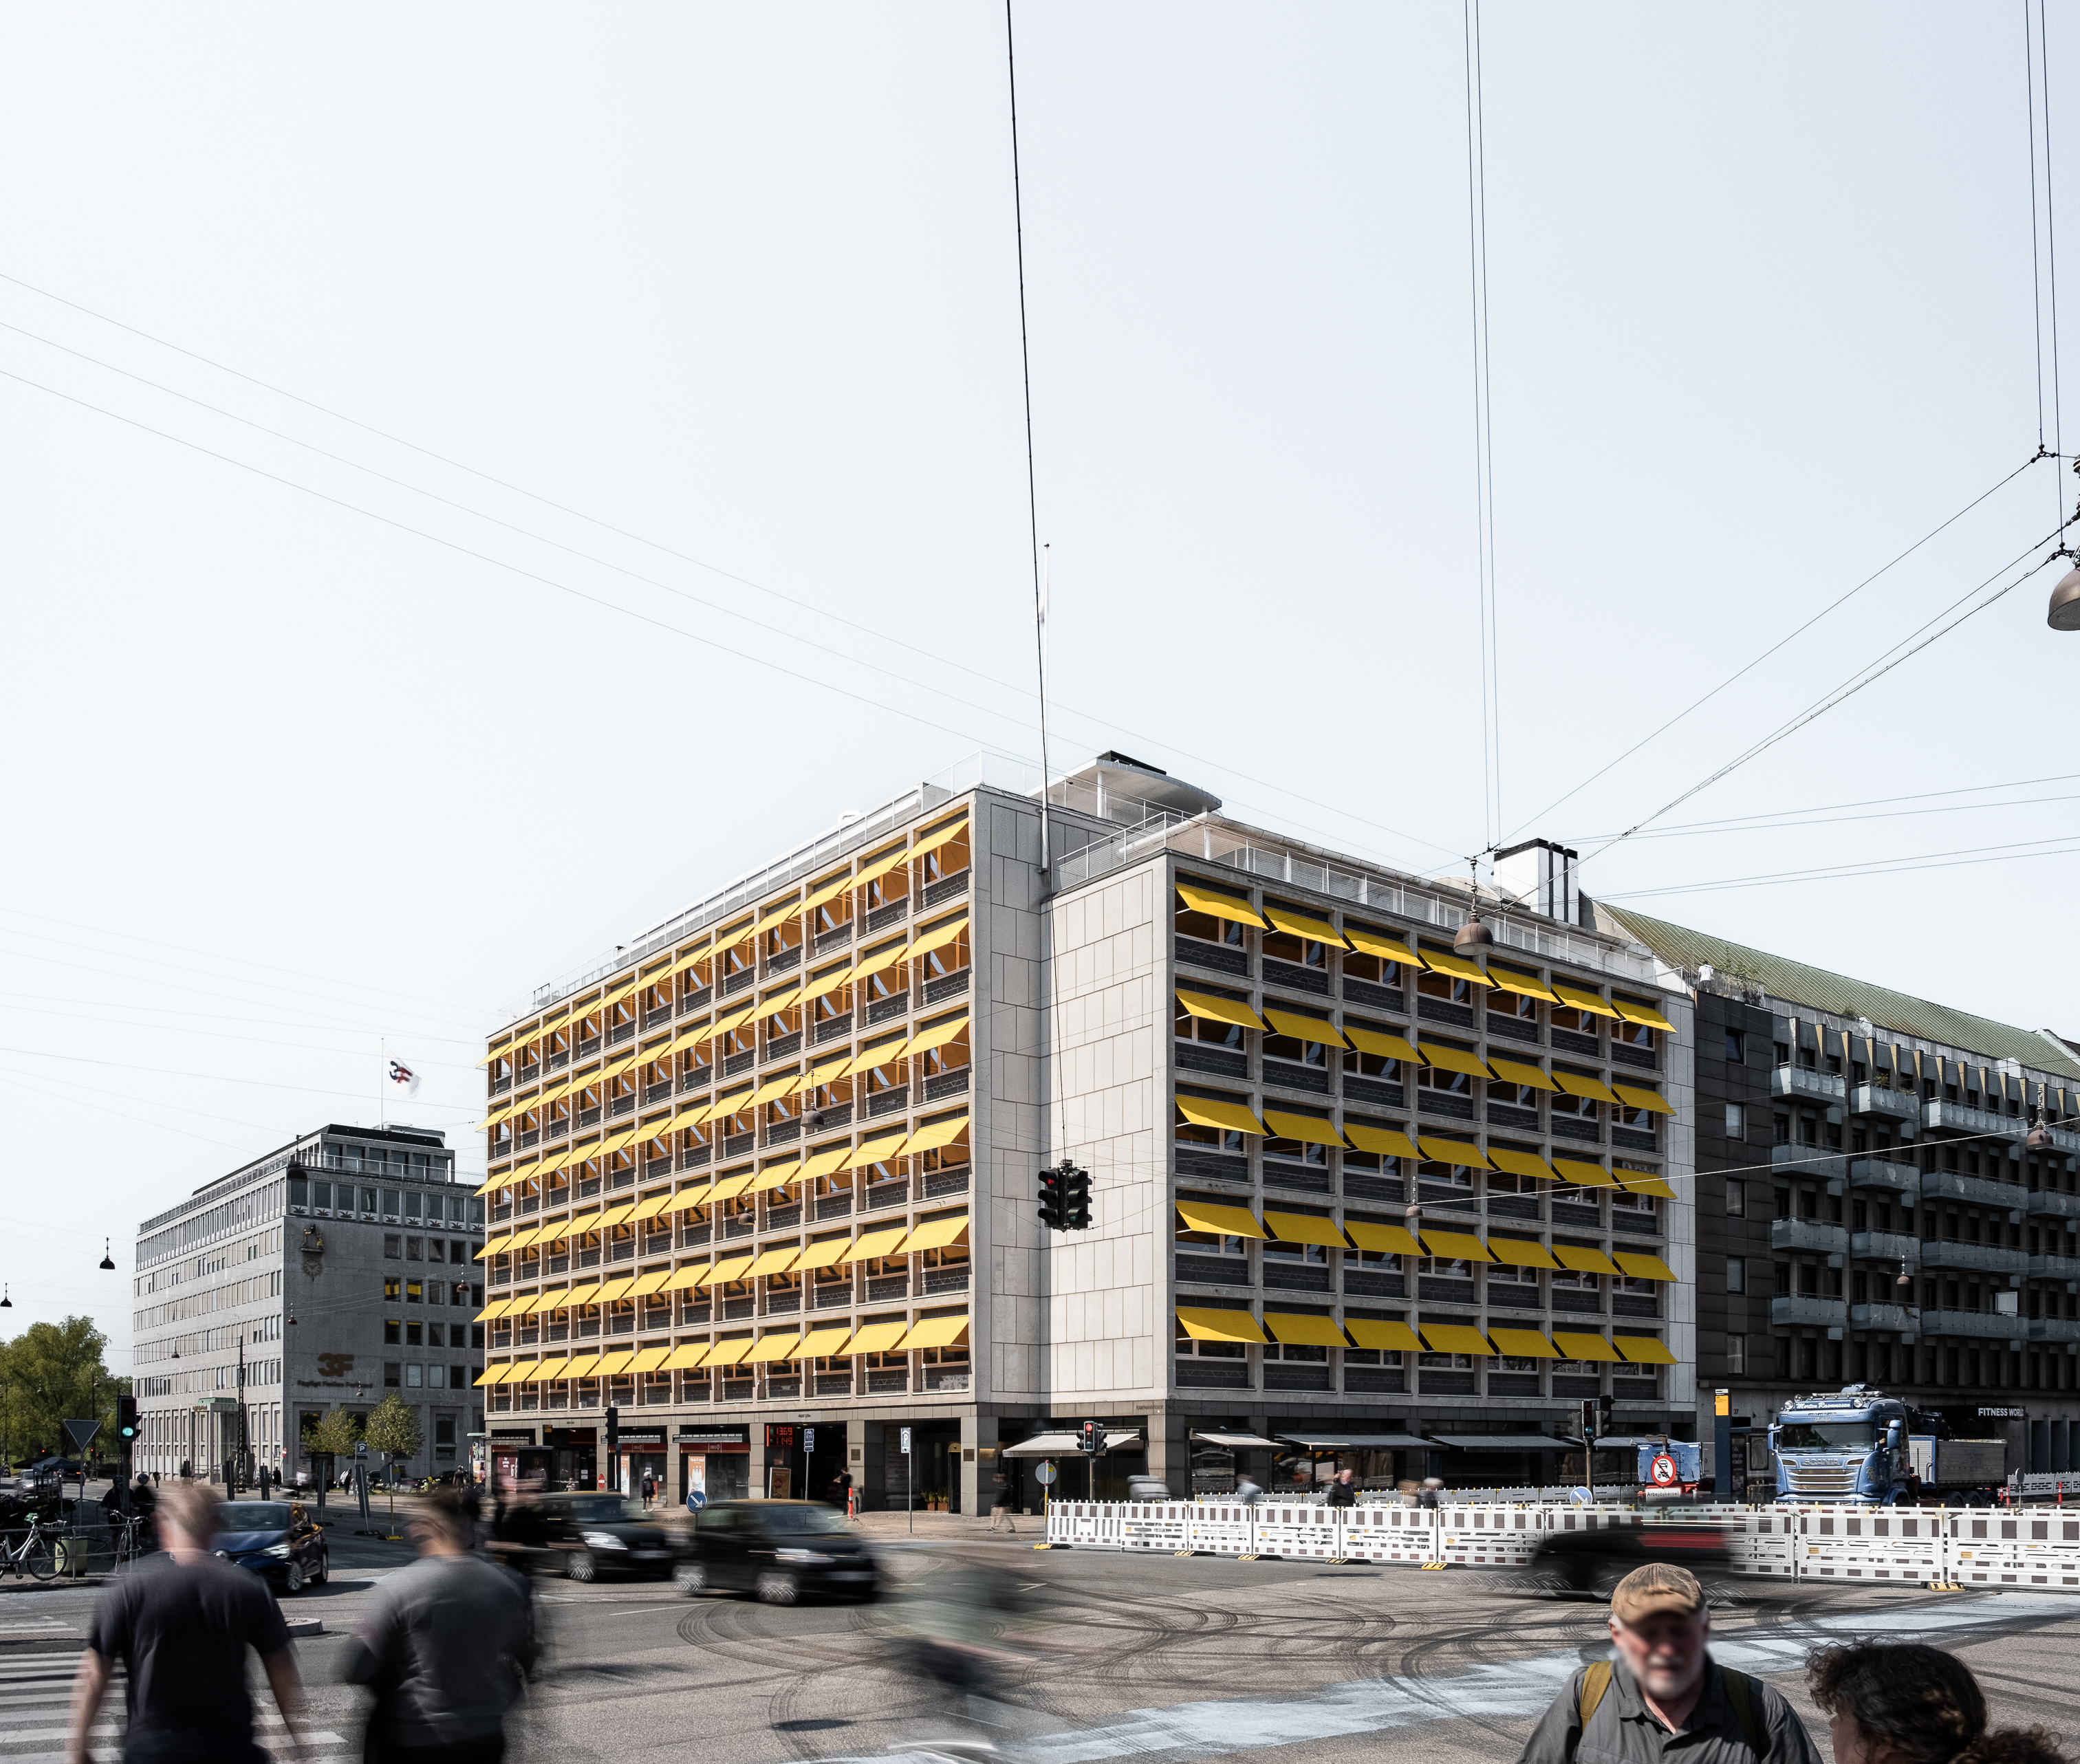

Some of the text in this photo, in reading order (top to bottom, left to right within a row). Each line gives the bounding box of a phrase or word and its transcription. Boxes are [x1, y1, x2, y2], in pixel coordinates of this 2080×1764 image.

[317, 1353, 354, 1377] 3F
[1978, 1408, 2024, 1417] FITNESS WORLD
[903, 1434, 908, 1444] P
